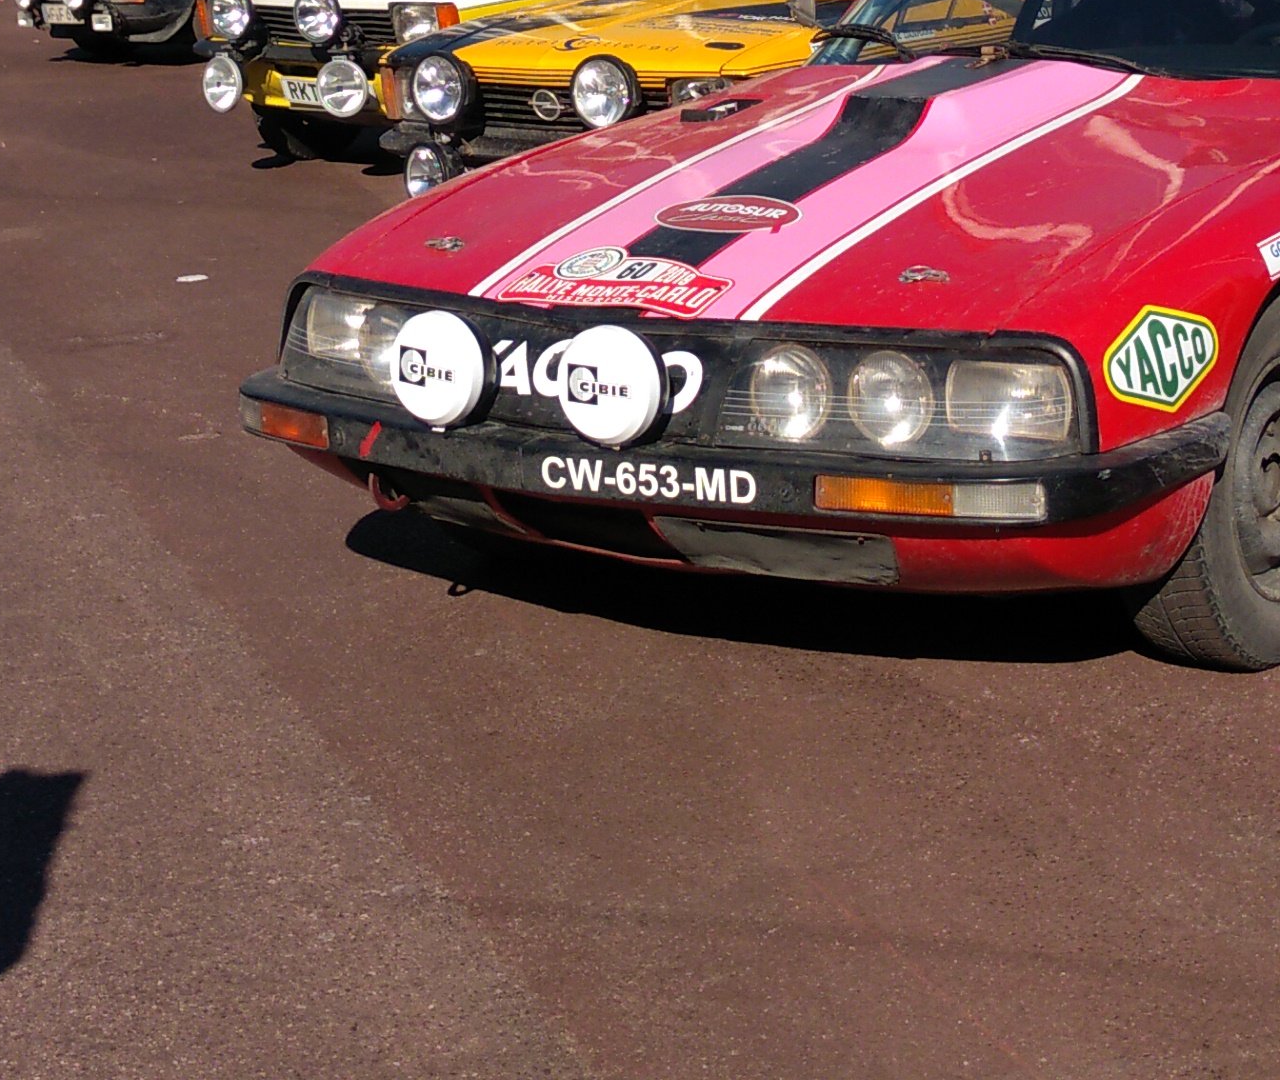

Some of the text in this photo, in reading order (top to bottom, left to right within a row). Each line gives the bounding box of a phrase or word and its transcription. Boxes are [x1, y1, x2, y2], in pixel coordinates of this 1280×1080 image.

[679, 203, 788, 220] AUTOSUR
[616, 262, 658, 280] 60
[509, 274, 717, 309] RALLYE MONTE-CARLO
[1116, 319, 1207, 398] YACCO
[541, 455, 757, 505] CW-653-MD
